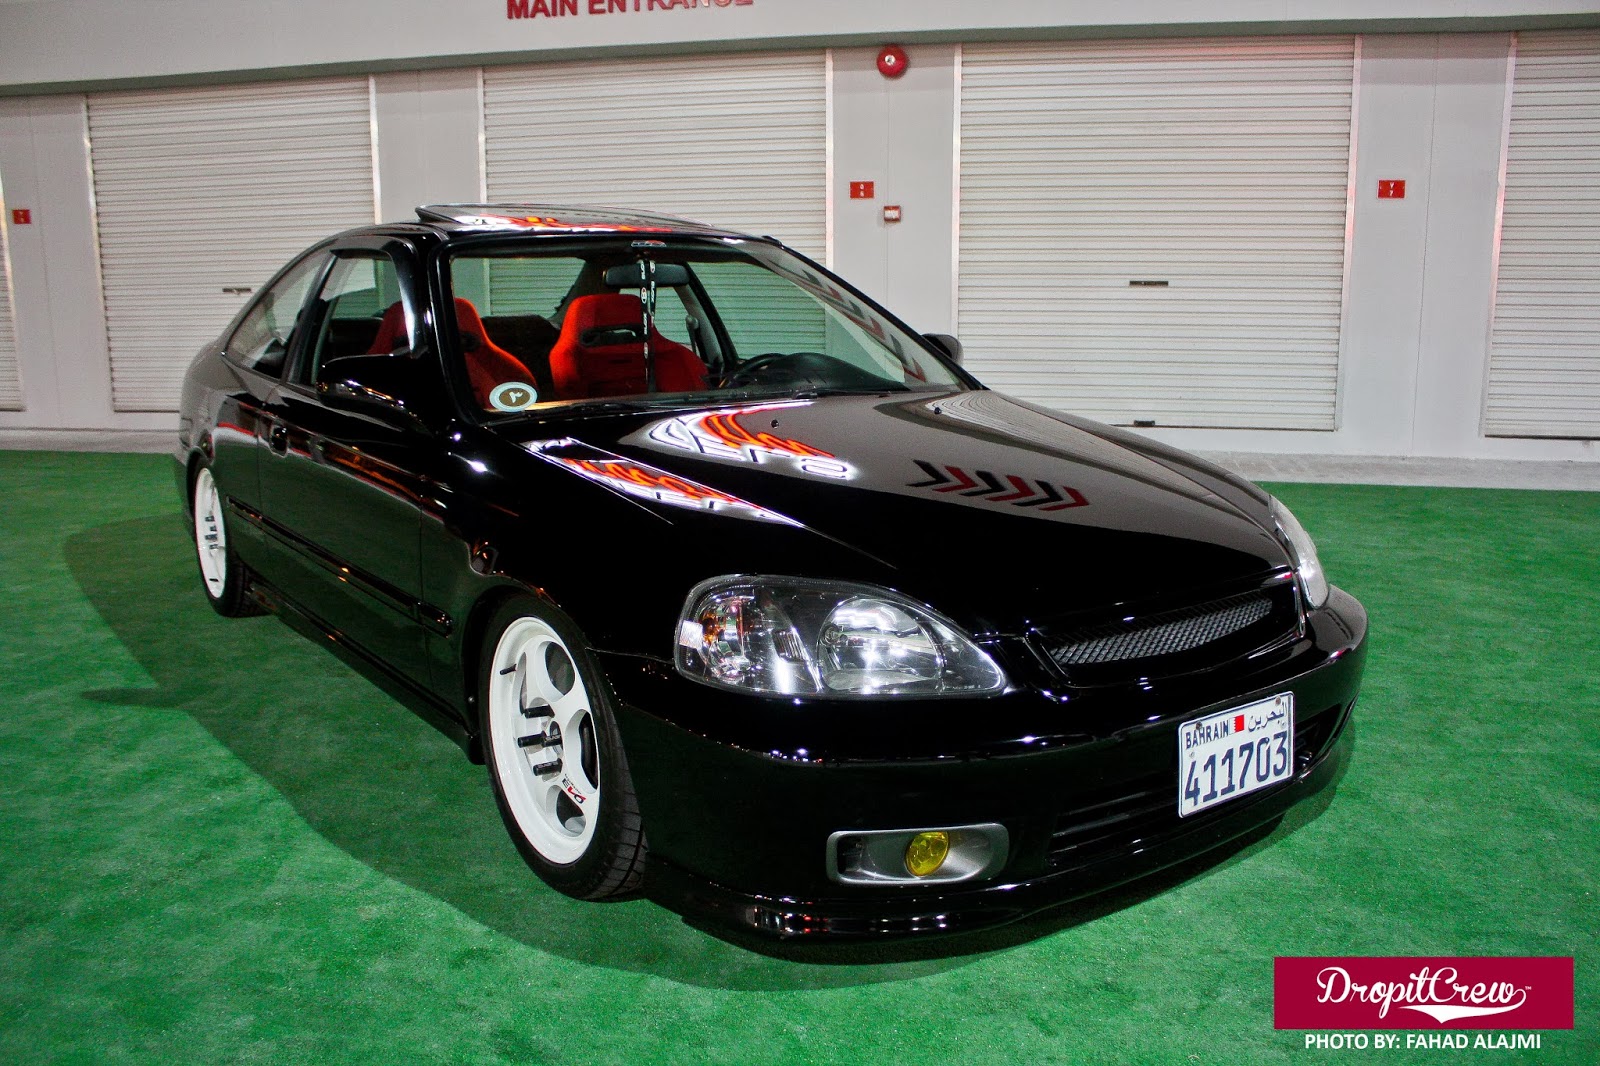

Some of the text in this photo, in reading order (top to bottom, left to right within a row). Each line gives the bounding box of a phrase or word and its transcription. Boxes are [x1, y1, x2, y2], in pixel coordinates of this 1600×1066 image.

[507, 0, 578, 19] MAIN
[1248, 701, 1288, 733] البحرين
[1185, 720, 1229, 750] BAHRAIN
[1184, 730, 1288, 807] 411703
